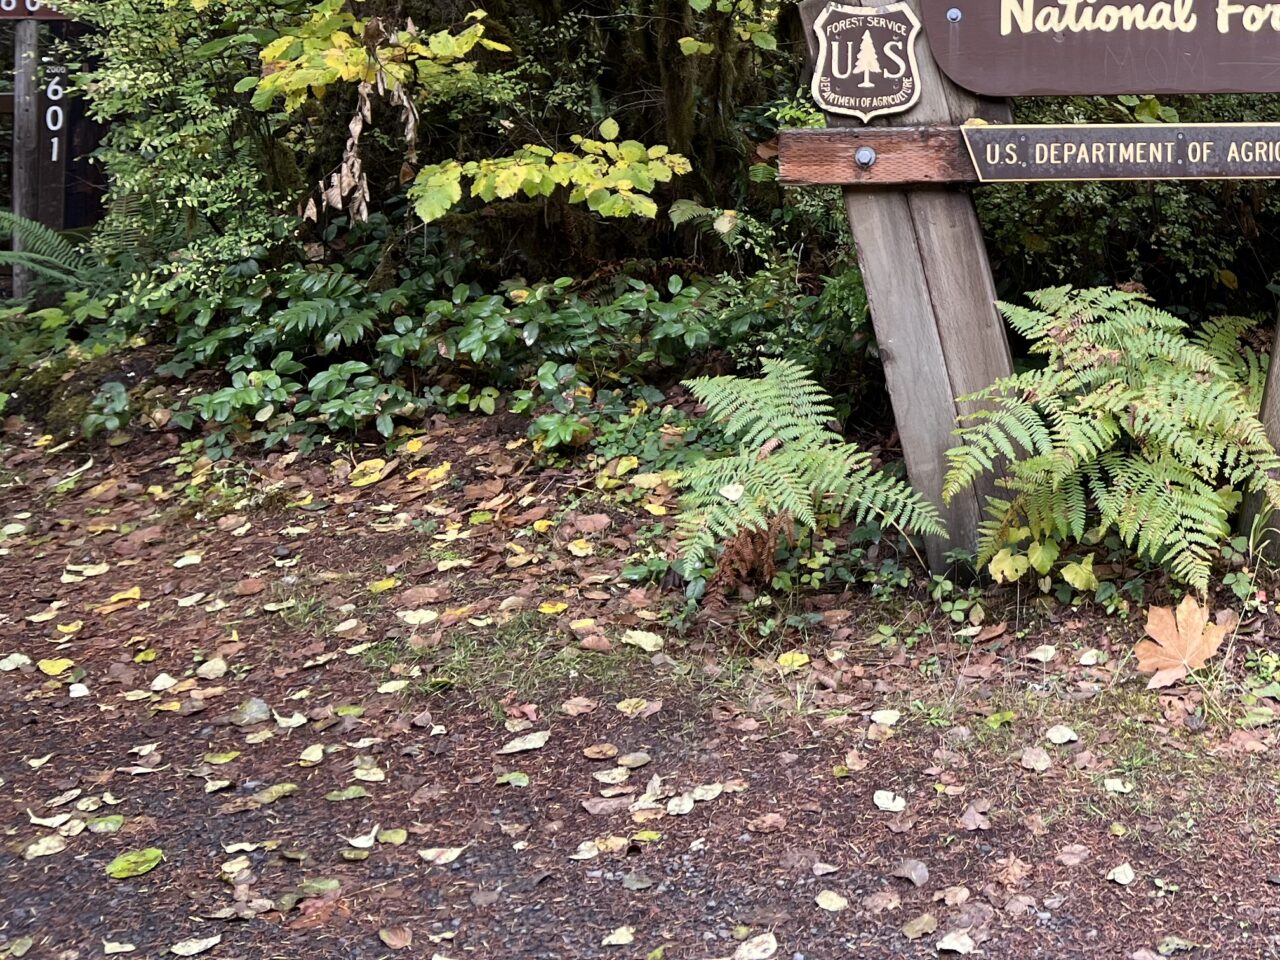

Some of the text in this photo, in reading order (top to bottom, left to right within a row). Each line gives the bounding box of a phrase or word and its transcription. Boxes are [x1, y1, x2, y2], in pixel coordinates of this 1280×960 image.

[827, 17, 907, 36] FOREST SERVICE
[820, 76, 913, 108] DEPARTMENT OF AGRICULTURE
[986, 142, 1023, 165] U.S.
[1035, 141, 1175, 165] DEPARTMENT
[1188, 140, 1213, 163] OF
